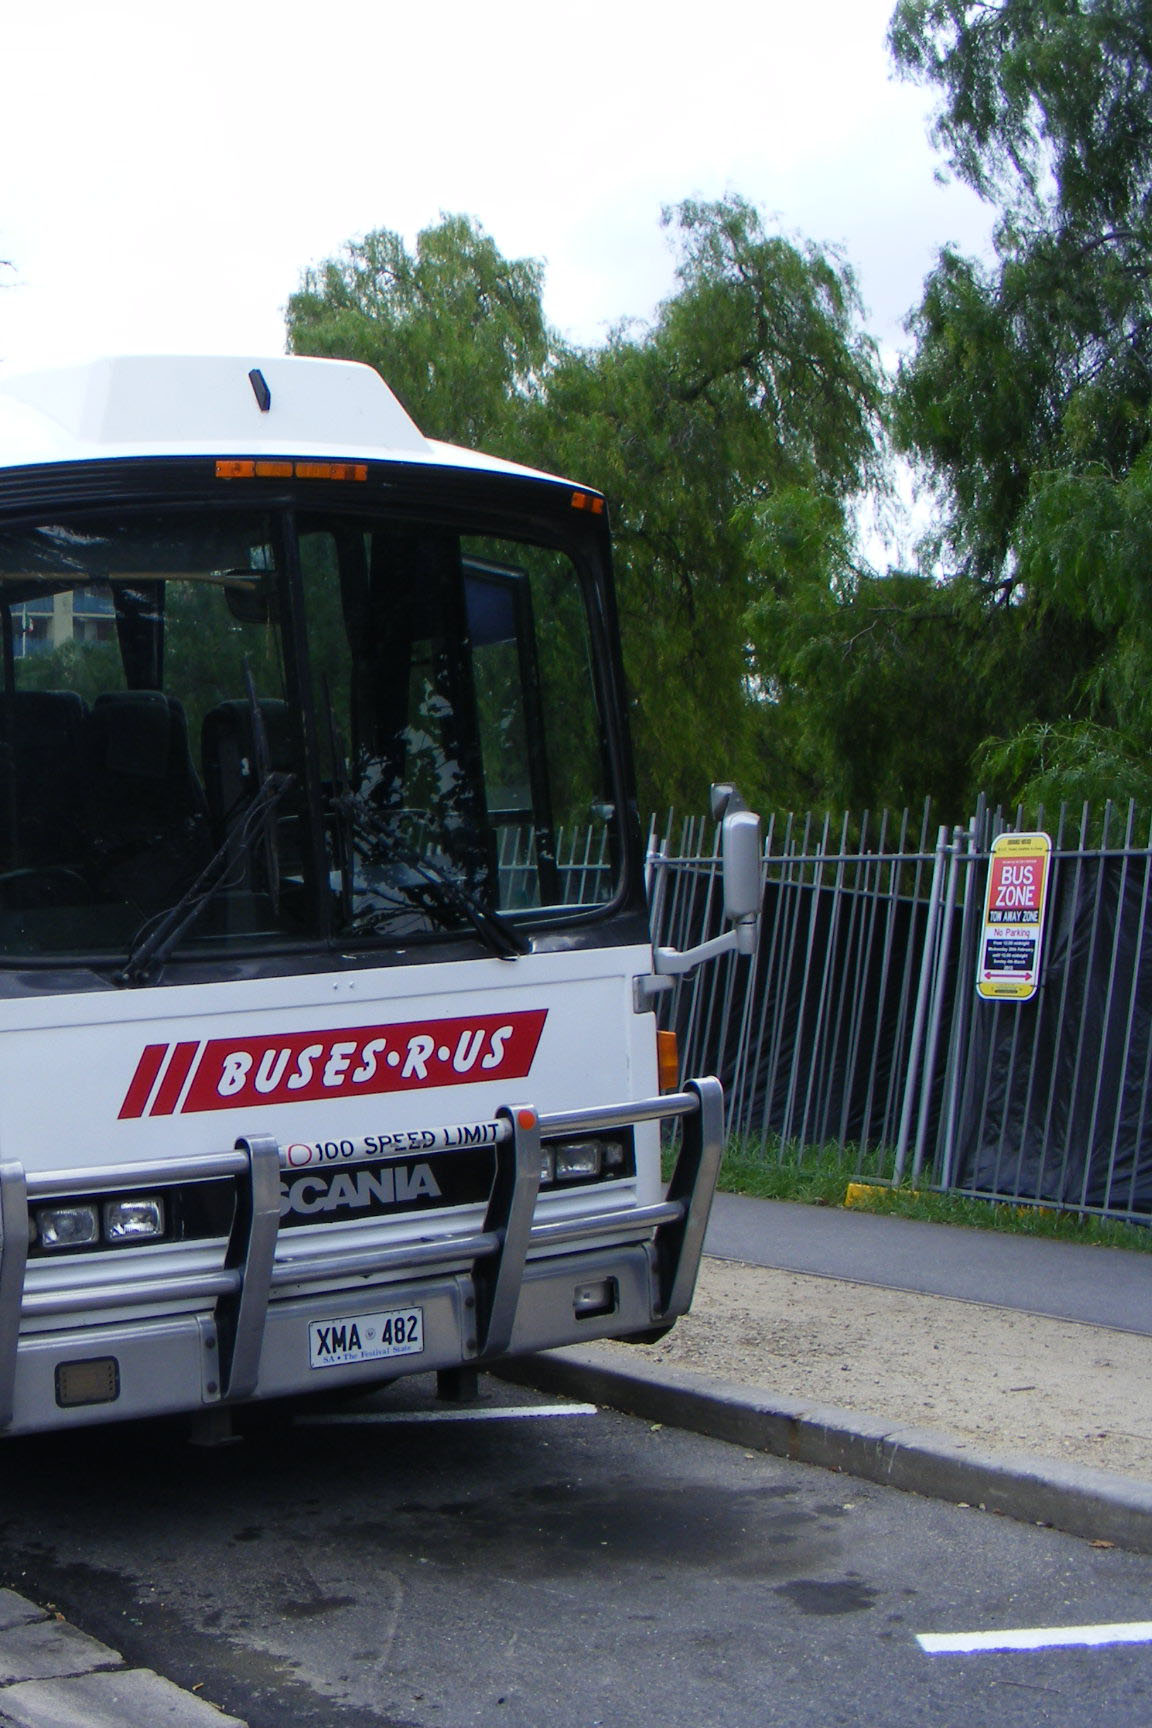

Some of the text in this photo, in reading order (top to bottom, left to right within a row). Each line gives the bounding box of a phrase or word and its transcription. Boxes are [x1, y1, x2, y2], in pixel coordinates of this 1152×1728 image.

[1001, 866, 1034, 885] BUS
[995, 886, 1036, 906] ZONE
[990, 910, 1039, 922] TOW AWAY ZONE
[994, 928, 1031, 939] No Parking
[315, 1123, 500, 1162] 100 SPEED LIMIT
[316, 1315, 418, 1356] XMA 482
[322, 1344, 412, 1364] SA The Festival State
